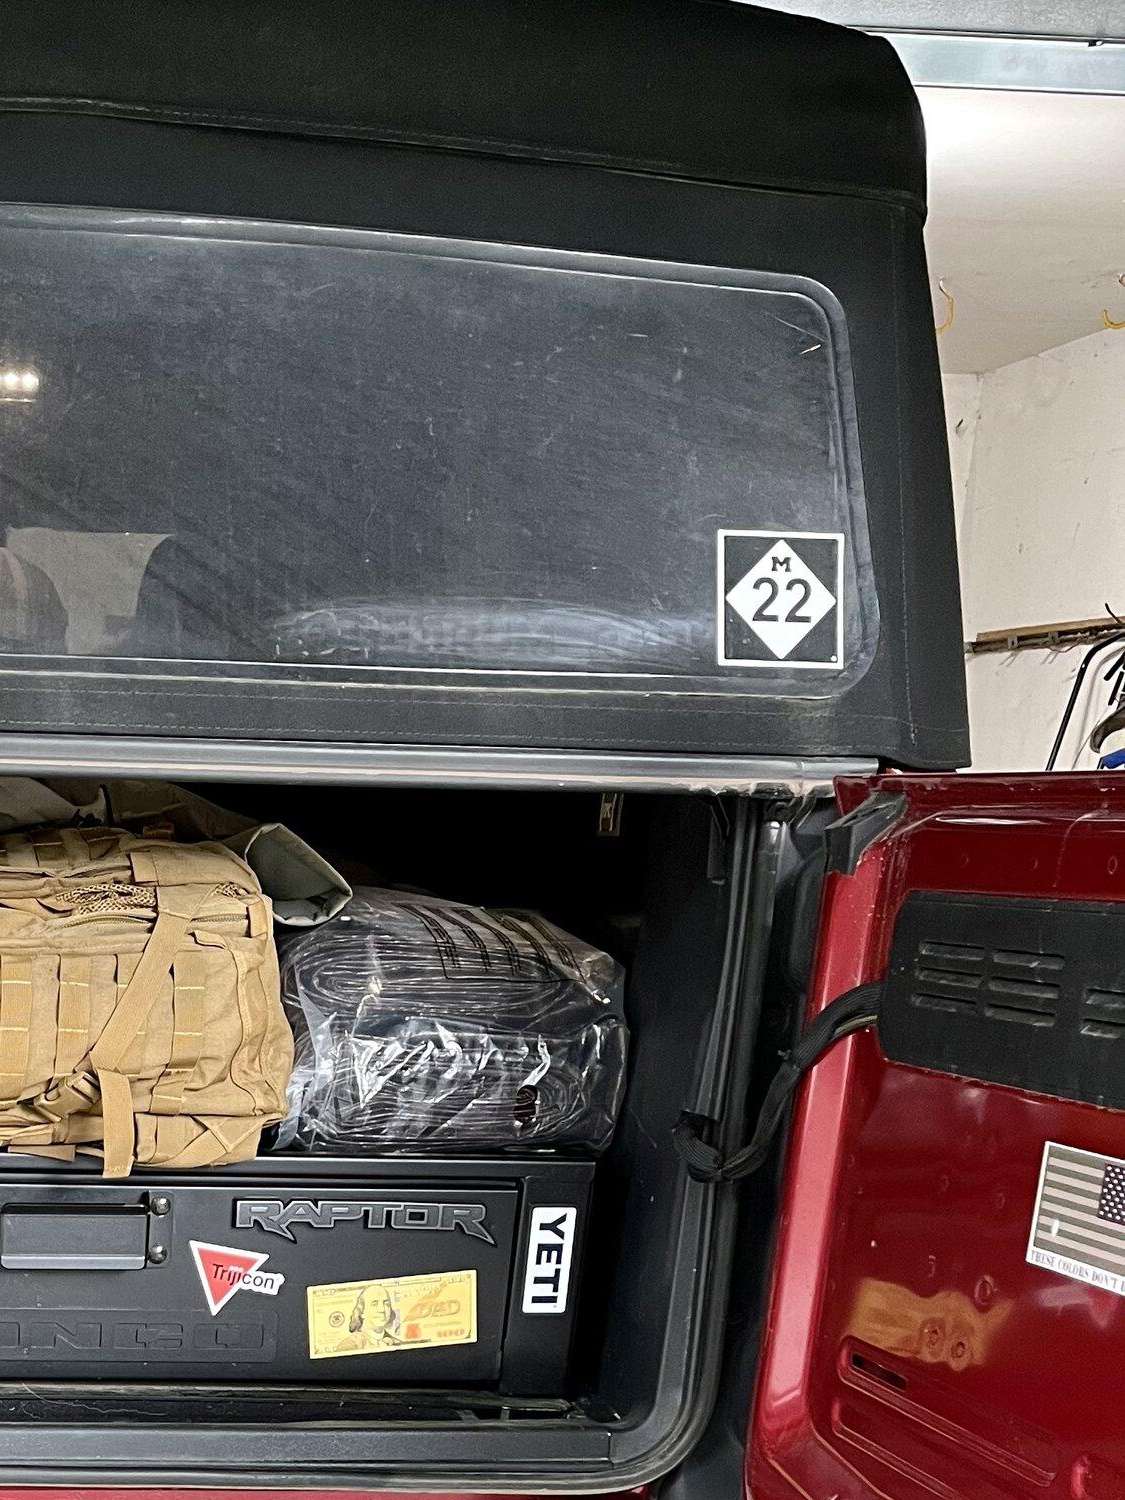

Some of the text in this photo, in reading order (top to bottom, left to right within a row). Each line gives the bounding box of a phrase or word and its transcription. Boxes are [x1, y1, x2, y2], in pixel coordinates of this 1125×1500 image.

[771, 556, 792, 573] M
[752, 577, 812, 623] 22
[235, 1200, 496, 1245] RAPTOR
[213, 1263, 274, 1290] Trijicon
[531, 1213, 567, 1304] YETI
